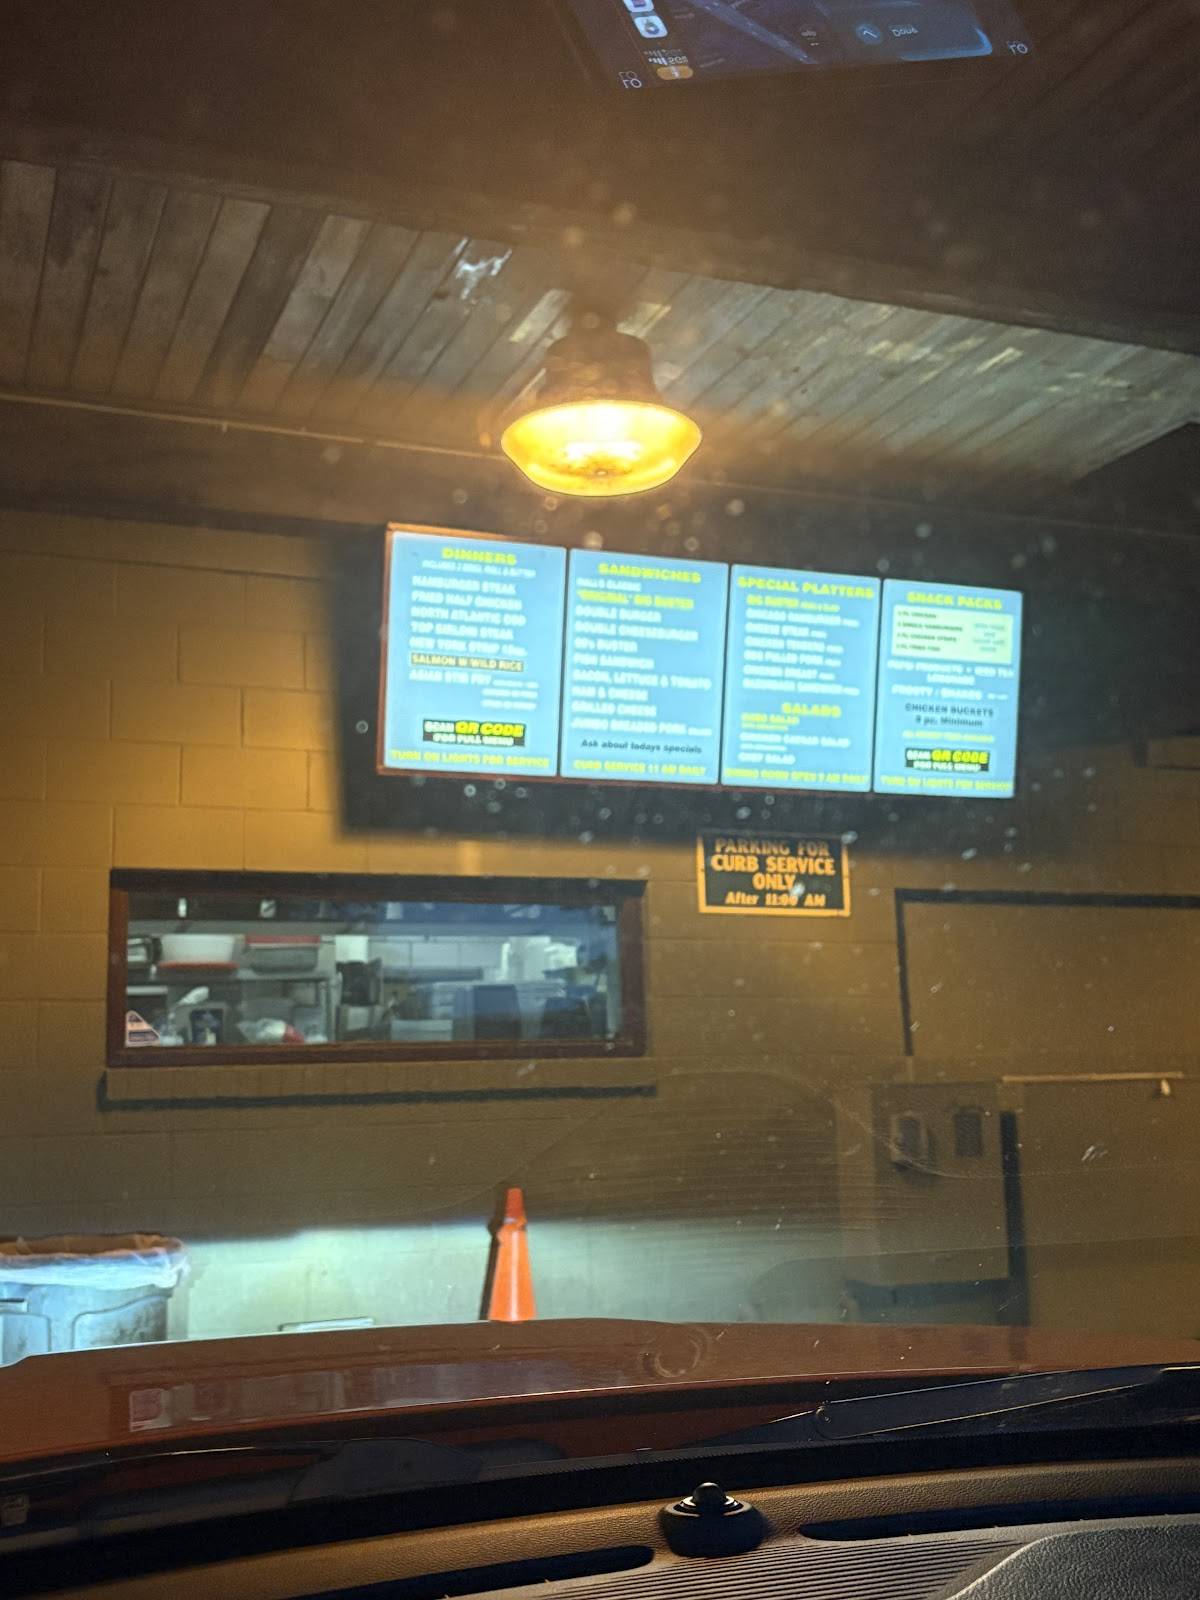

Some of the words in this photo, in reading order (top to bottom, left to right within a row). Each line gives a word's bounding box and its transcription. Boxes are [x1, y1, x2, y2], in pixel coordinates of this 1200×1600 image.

[442, 547, 517, 566] DINNERS
[598, 563, 701, 583] SANDWICHES
[737, 576, 799, 593] SPECIAL
[802, 581, 874, 599] PLATTERS
[906, 592, 953, 605] SNACK
[957, 595, 1002, 609] PACKS
[411, 607, 449, 620] NORTH
[450, 609, 502, 624] ATLANTIC
[412, 653, 456, 666] SALMON
[468, 657, 496, 669] WILD
[499, 660, 522, 672] RICE
[781, 702, 841, 718] SALADS
[905, 702, 948, 714] CHICKEN
[950, 704, 994, 718] BUCKETS
[424, 721, 454, 734] SCAN
[455, 720, 480, 735] QR
[480, 721, 524, 737] CODE
[941, 717, 983, 728] Minimum
[457, 735, 481, 745] FULL
[581, 739, 598, 748] Ask
[601, 741, 628, 750] about
[631, 741, 661, 753] todays
[663, 744, 702, 754] specials
[391, 749, 421, 761] TURN
[442, 751, 480, 764] LIGHTS
[506, 756, 549, 768] SERVICE
[715, 838, 790, 855] PARKING
[798, 841, 830, 856] FOR
[711, 854, 759, 872] CURB
[766, 856, 836, 876] SERVICE
[752, 872, 796, 890] ONLY
[725, 891, 759, 906] After
[766, 893, 799, 906] 11:00
[804, 893, 826, 907] AM
